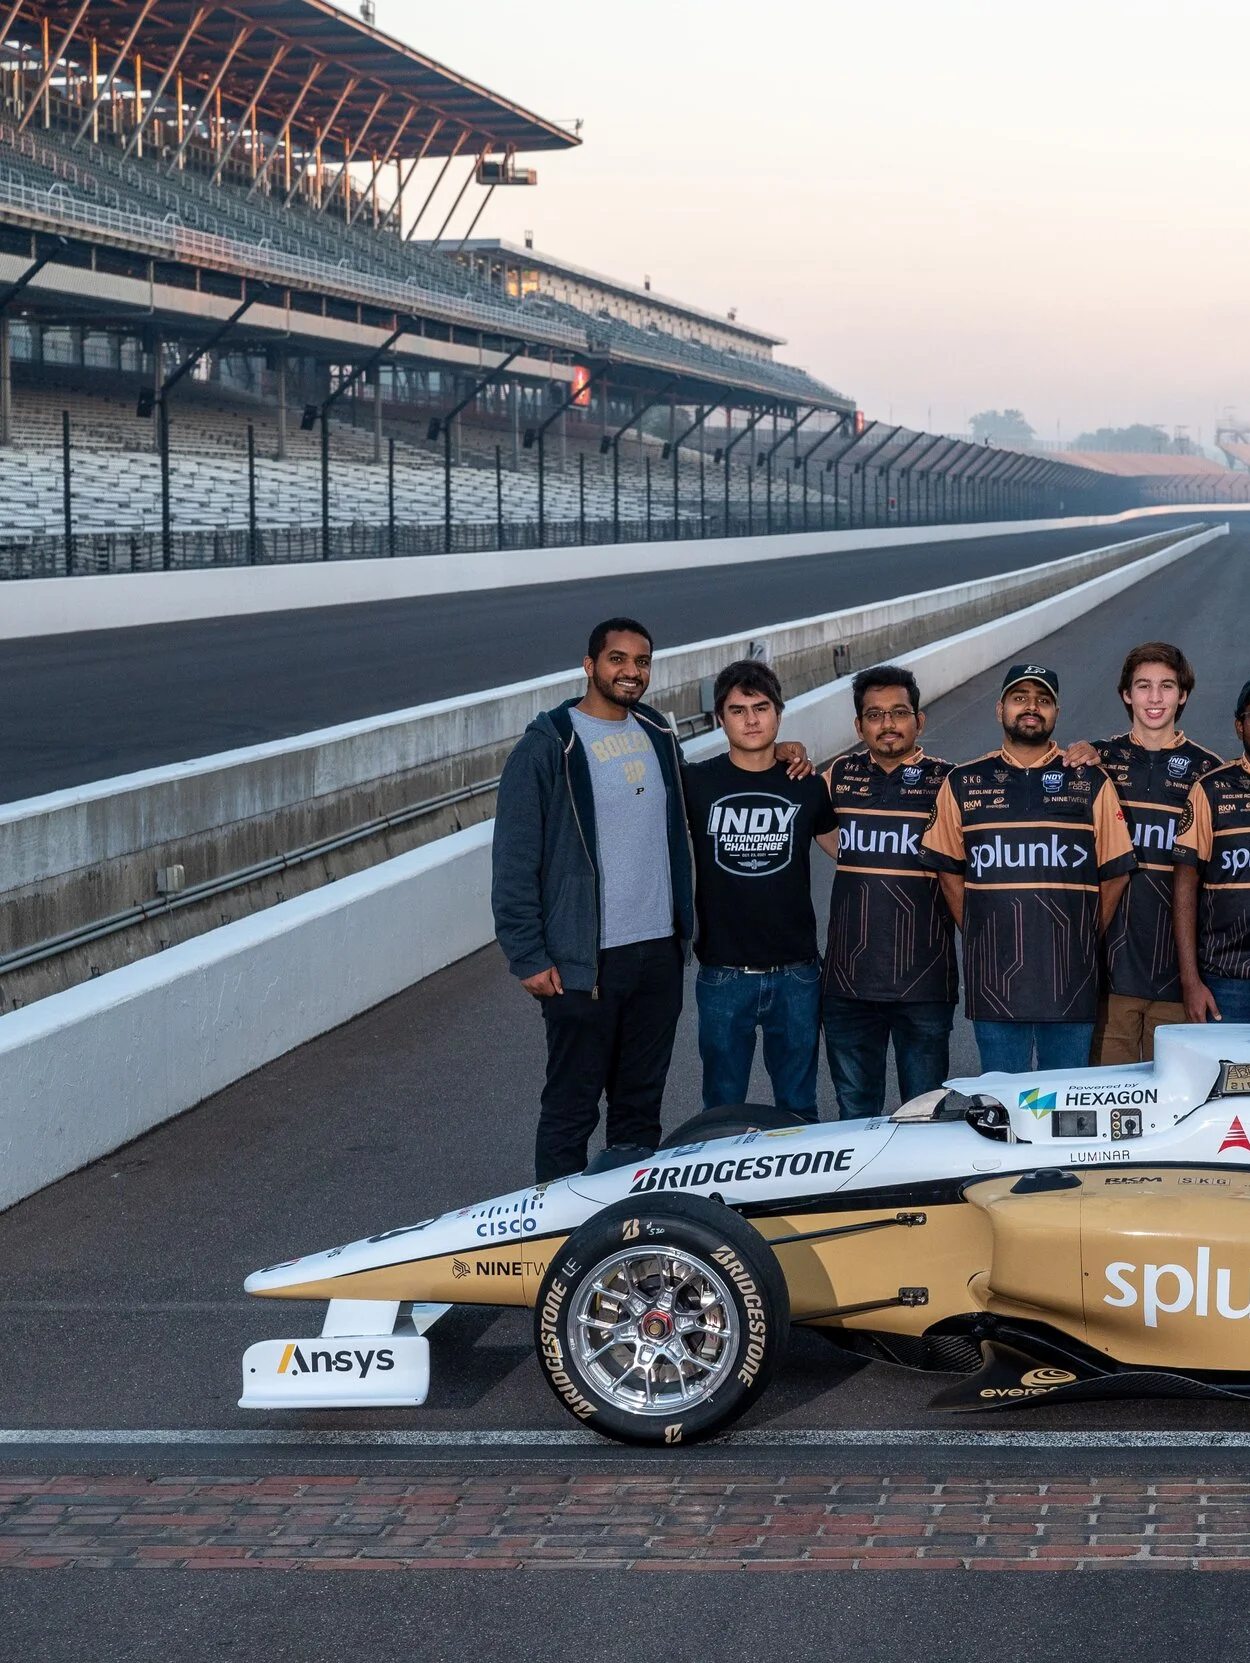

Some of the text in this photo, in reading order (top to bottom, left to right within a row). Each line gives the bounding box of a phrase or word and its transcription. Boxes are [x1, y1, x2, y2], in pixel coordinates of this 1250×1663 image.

[624, 760, 646, 784] UP
[1042, 773, 1064, 781] INDY
[635, 787, 645, 795] P
[963, 799, 982, 809] RKM
[1218, 803, 1236, 812] RKM
[710, 806, 797, 834] INDY
[719, 833, 789, 843] AUTONOMOUS
[838, 821, 920, 858] plunk
[724, 842, 784, 851] CHALLENGE
[1068, 1083, 1121, 1091] Powered
[1065, 1088, 1158, 1106] HEXAGON
[1070, 1149, 1131, 1163] LUMINAR
[629, 1147, 855, 1194] BRIDGESTONE
[1104, 1176, 1163, 1184] RKM
[476, 1217, 537, 1237] CISCO
[476, 1261, 549, 1277] NINETW
[709, 1244, 767, 1389] BRIDGESTONE
[540, 1278, 599, 1420] BRIDGESTONE
[277, 1343, 395, 1378] Ansys
